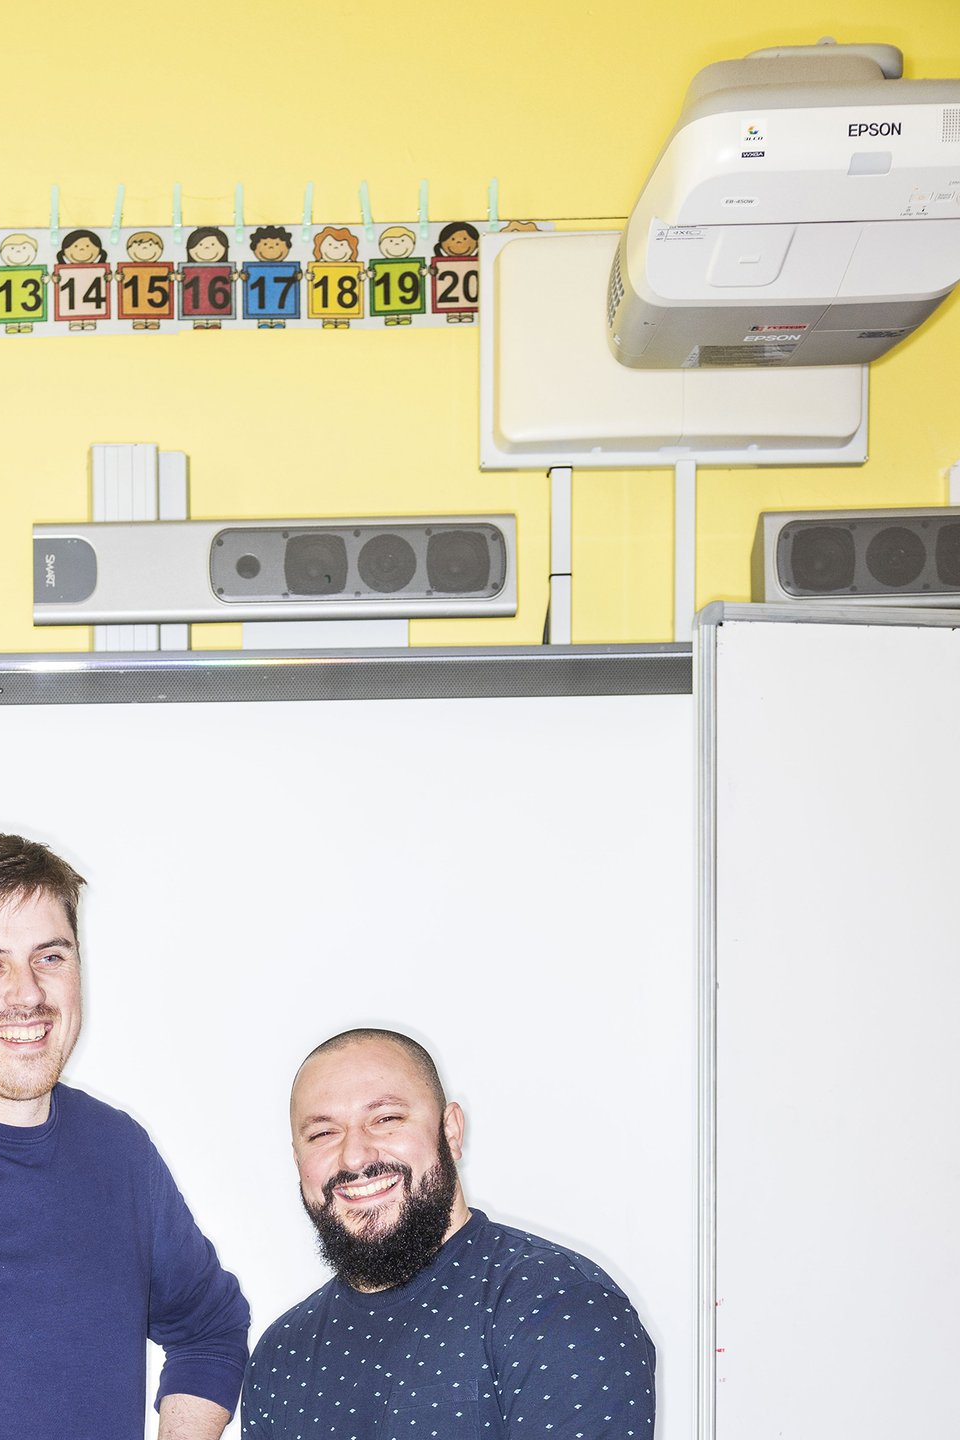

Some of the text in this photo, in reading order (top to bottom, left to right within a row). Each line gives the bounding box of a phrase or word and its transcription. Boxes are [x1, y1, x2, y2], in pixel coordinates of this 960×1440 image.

[848, 122, 902, 137] EPSON
[61, 277, 106, 309] 14
[125, 275, 170, 307] 15
[186, 276, 231, 309] 16
[251, 275, 297, 309] 17
[315, 276, 357, 308] 18
[376, 272, 420, 305] 19
[439, 271, 479, 303] 20
[743, 334, 802, 342] EPSON
[45, 554, 56, 588] SMART
